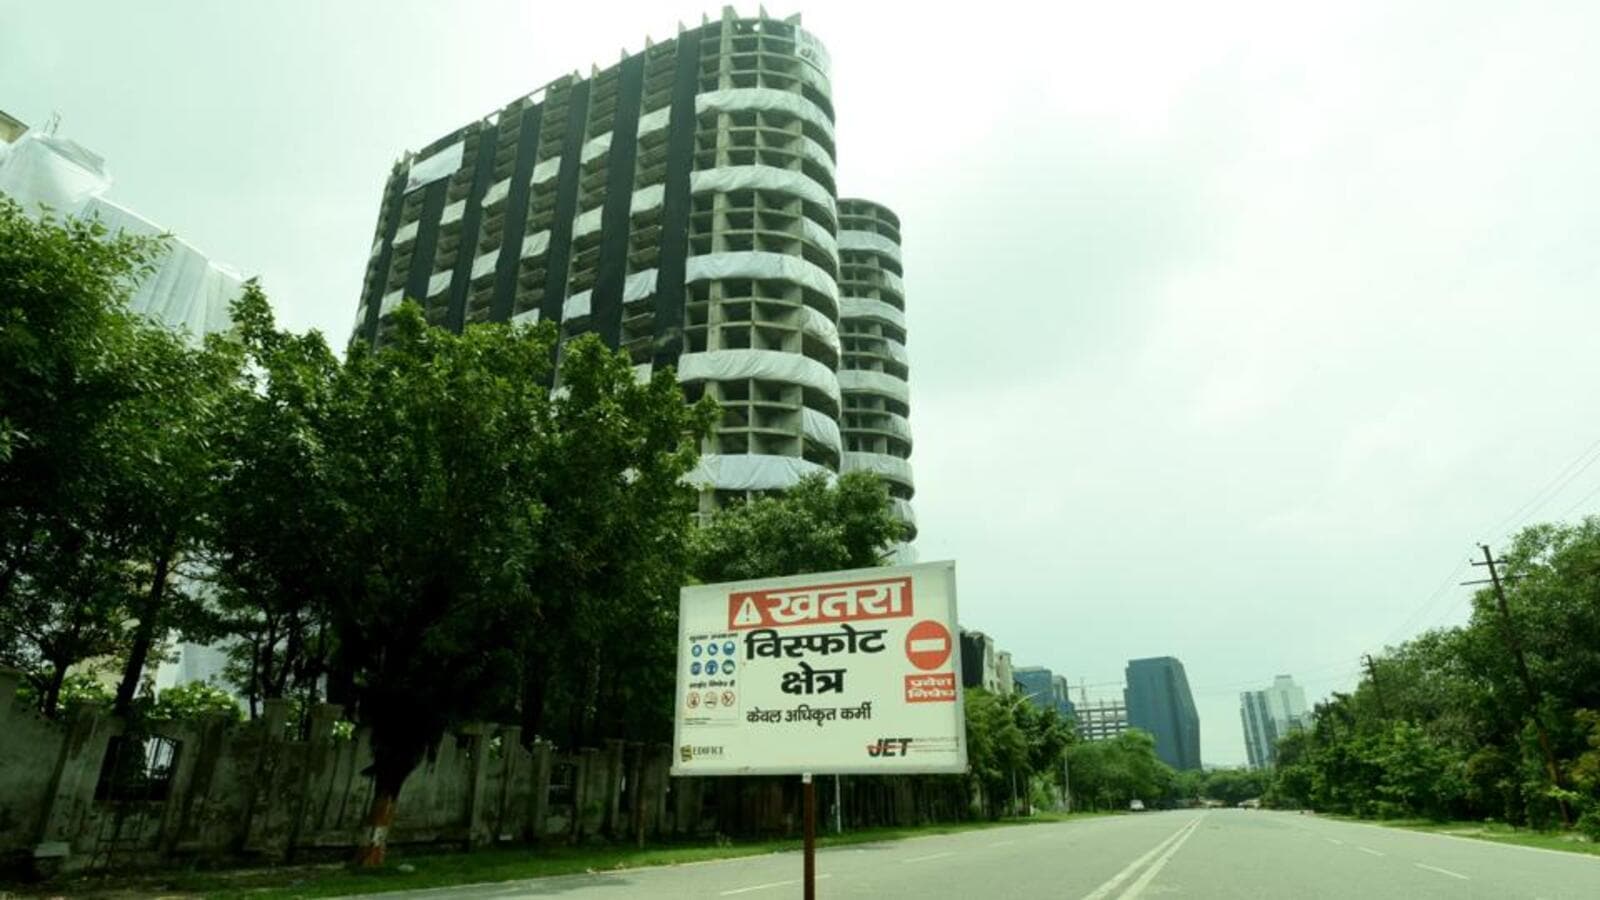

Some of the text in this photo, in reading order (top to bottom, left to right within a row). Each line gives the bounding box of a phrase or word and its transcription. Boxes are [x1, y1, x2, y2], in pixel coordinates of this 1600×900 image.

[765, 581, 906, 623] खतरा
[744, 623, 888, 660] विस्फोट
[781, 661, 847, 694] क्षेत्र
[746, 707, 782, 723] केवल
[785, 704, 837, 727] अधिकृत
[840, 701, 872, 720] कर्मी
[692, 745, 724, 756] EDIFICE
[867, 738, 913, 757] JET
